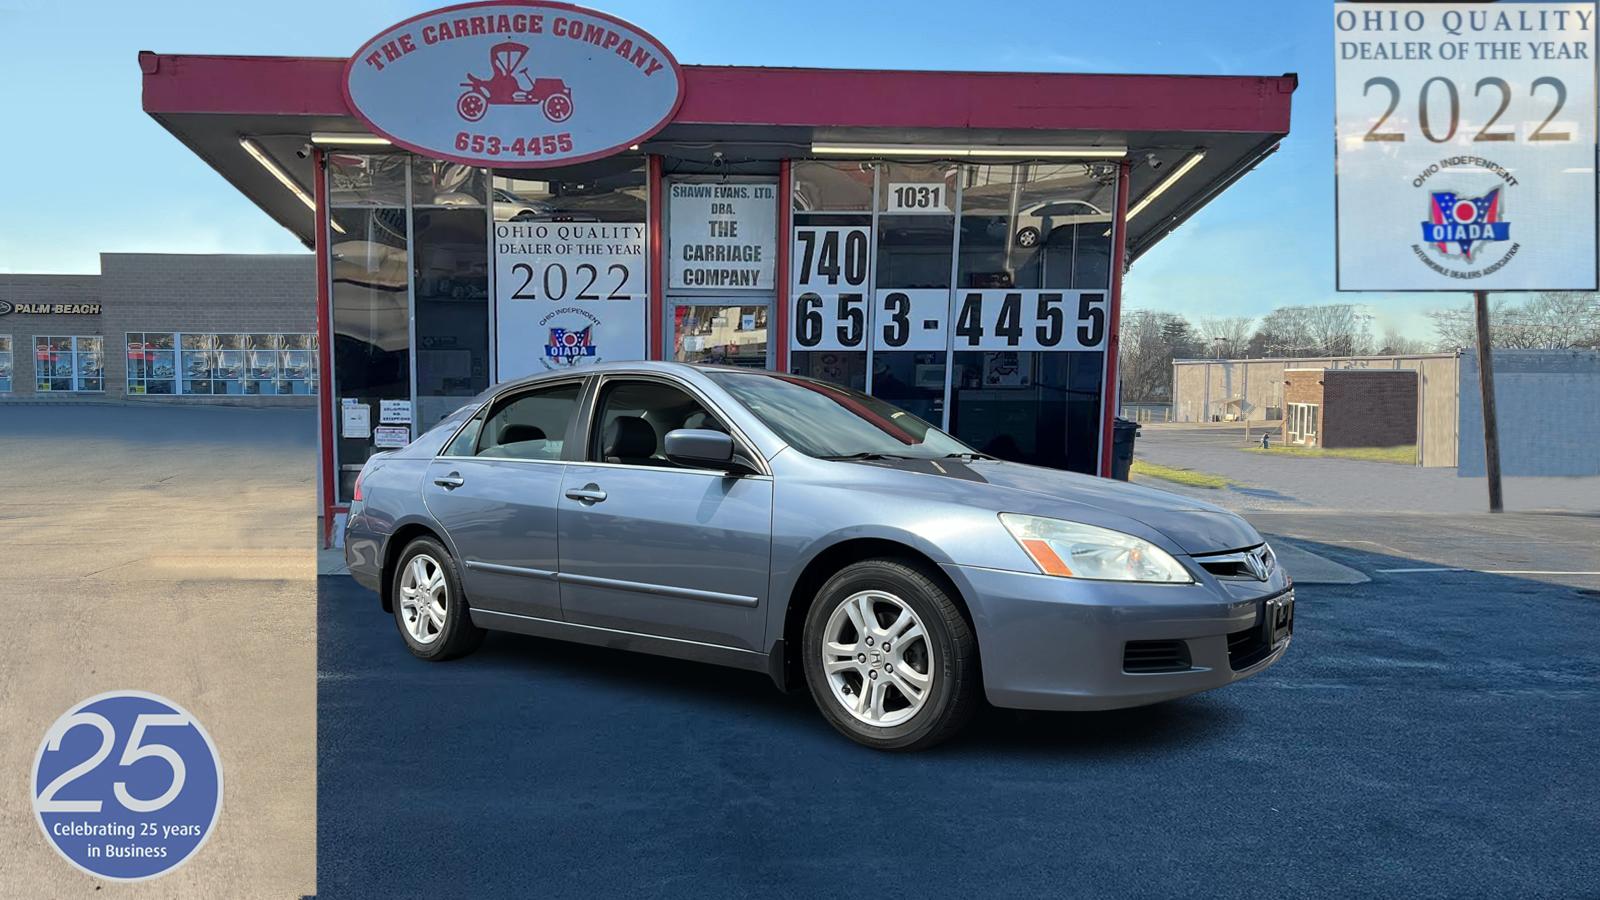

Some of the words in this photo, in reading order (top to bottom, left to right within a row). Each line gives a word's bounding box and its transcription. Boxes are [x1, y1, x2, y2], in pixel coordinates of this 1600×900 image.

[1336, 9, 1425, 32] OHIO
[1441, 9, 1593, 36] QUALITY
[366, 34, 416, 72] THE
[422, 14, 543, 45] CARRIAGE
[552, 16, 664, 77] COMPANY
[1340, 41, 1433, 60] DEALER
[1438, 41, 1469, 60] OF
[1475, 41, 1522, 60] THE
[1528, 41, 1589, 60] YEAR
[1362, 76, 1571, 143] 2022
[455, 132, 573, 157] 653-4455
[1412, 164, 1440, 188] OHIO
[1439, 155, 1519, 188] INDEPENDENT
[672, 186, 712, 199] SHAWN
[754, 187, 775, 199] LTD.
[894, 186, 941, 208] 1031
[711, 203, 736, 215] DBA.
[496, 225, 549, 239] OHIO
[558, 225, 645, 240] QUALITY
[708, 220, 738, 238] THE
[1433, 225, 1495, 240] OIADA
[499, 243, 552, 255] DEALER
[555, 243, 574, 255] OF
[576, 243, 603, 255] THE
[605, 243, 642, 255] YEAR
[682, 244, 762, 262] CARRIAGE
[797, 229, 868, 286] 740
[1411, 243, 1450, 277] AUTOMOBILE
[1449, 270, 1482, 280] DEALERS
[511, 262, 632, 301] 2022
[683, 268, 760, 286] COMPANY
[15, 304, 50, 314] PALM
[54, 304, 100, 314] BEACH
[539, 312, 555, 327] OHIO
[555, 307, 600, 326] INDEPENDENT
[551, 347, 588, 356] OIADA
